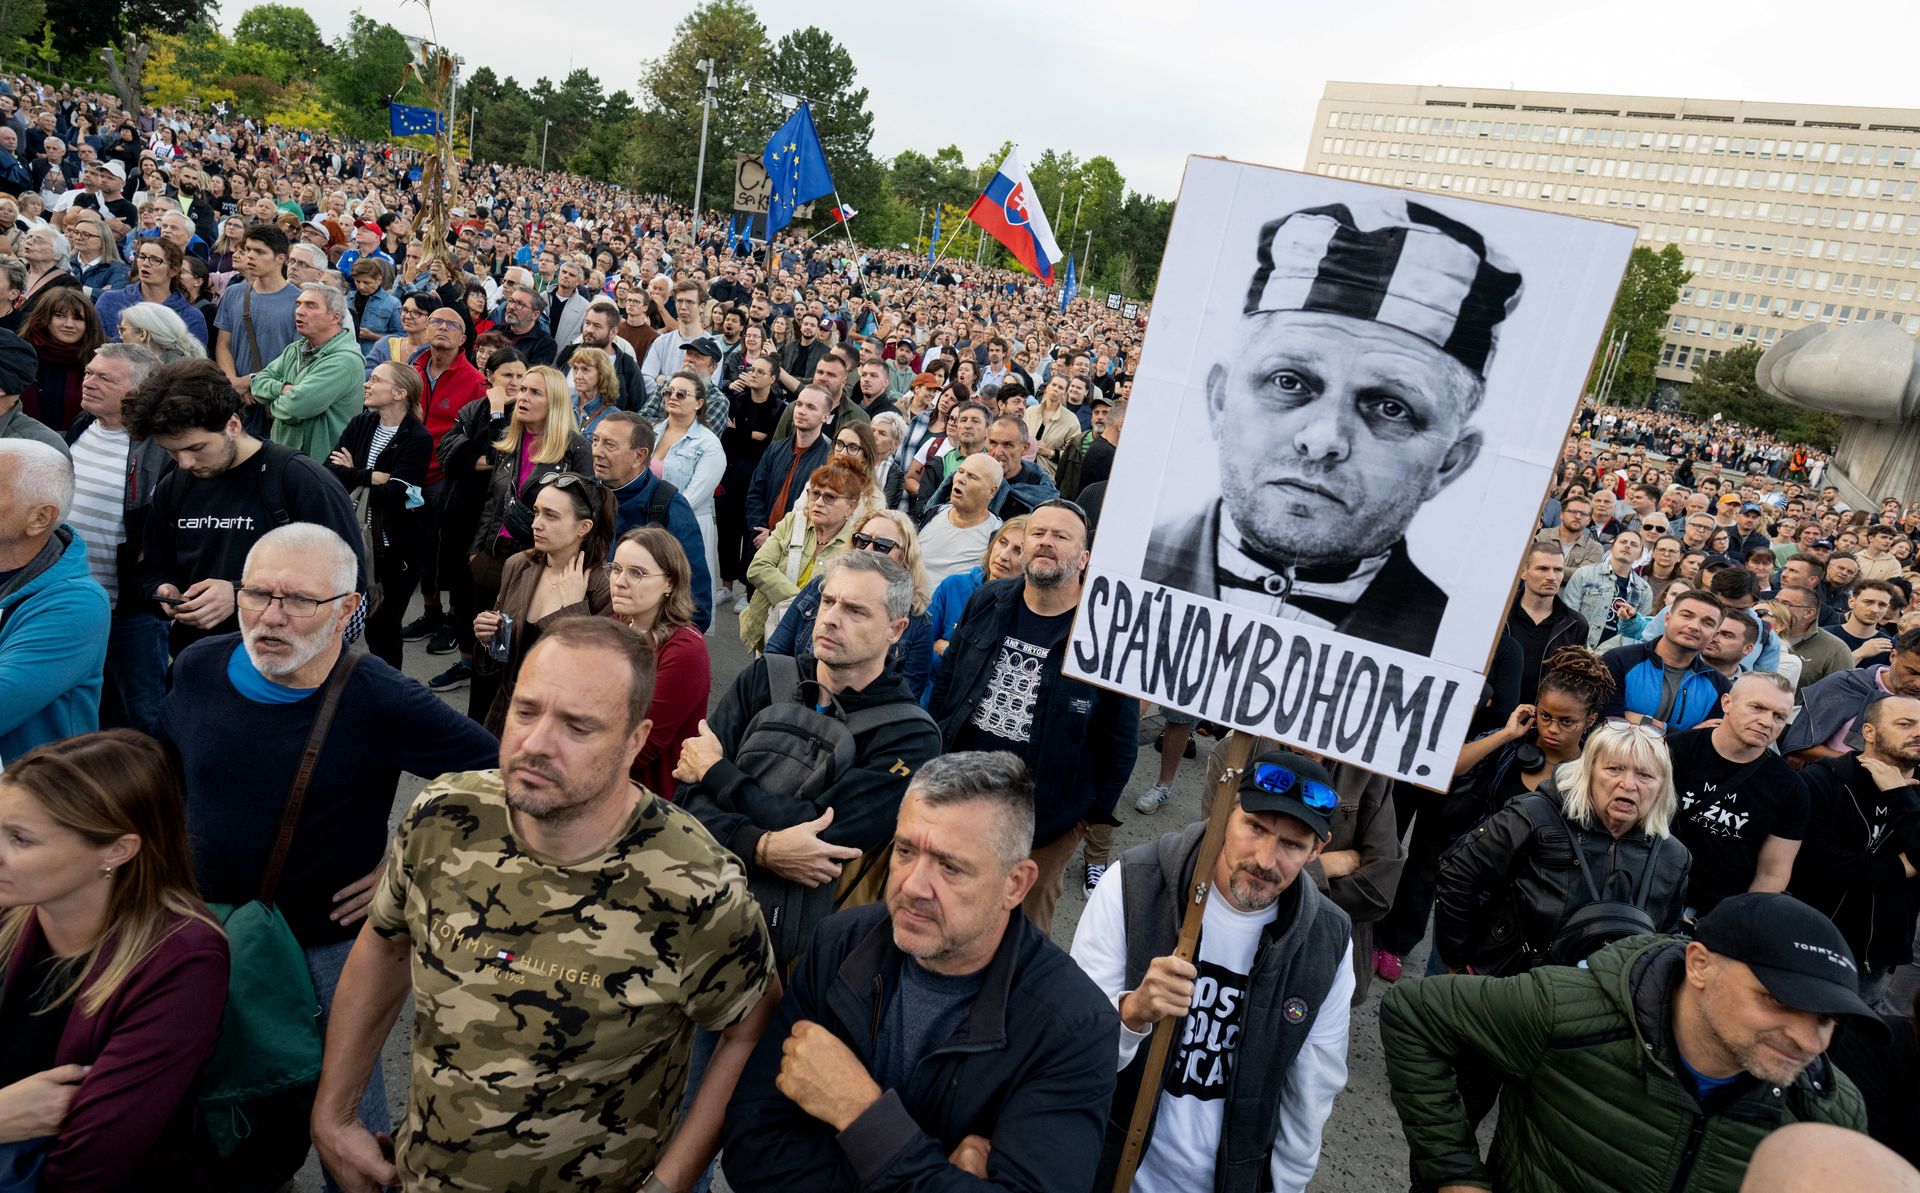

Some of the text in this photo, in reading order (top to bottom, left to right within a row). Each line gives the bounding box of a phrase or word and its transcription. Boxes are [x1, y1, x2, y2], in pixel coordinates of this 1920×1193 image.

[177, 515, 255, 531] carhartt
[431, 917, 602, 988] TOMMY HILFIGER
[1793, 941, 1833, 956] TOMMY
[503, 972, 526, 985] 1985
